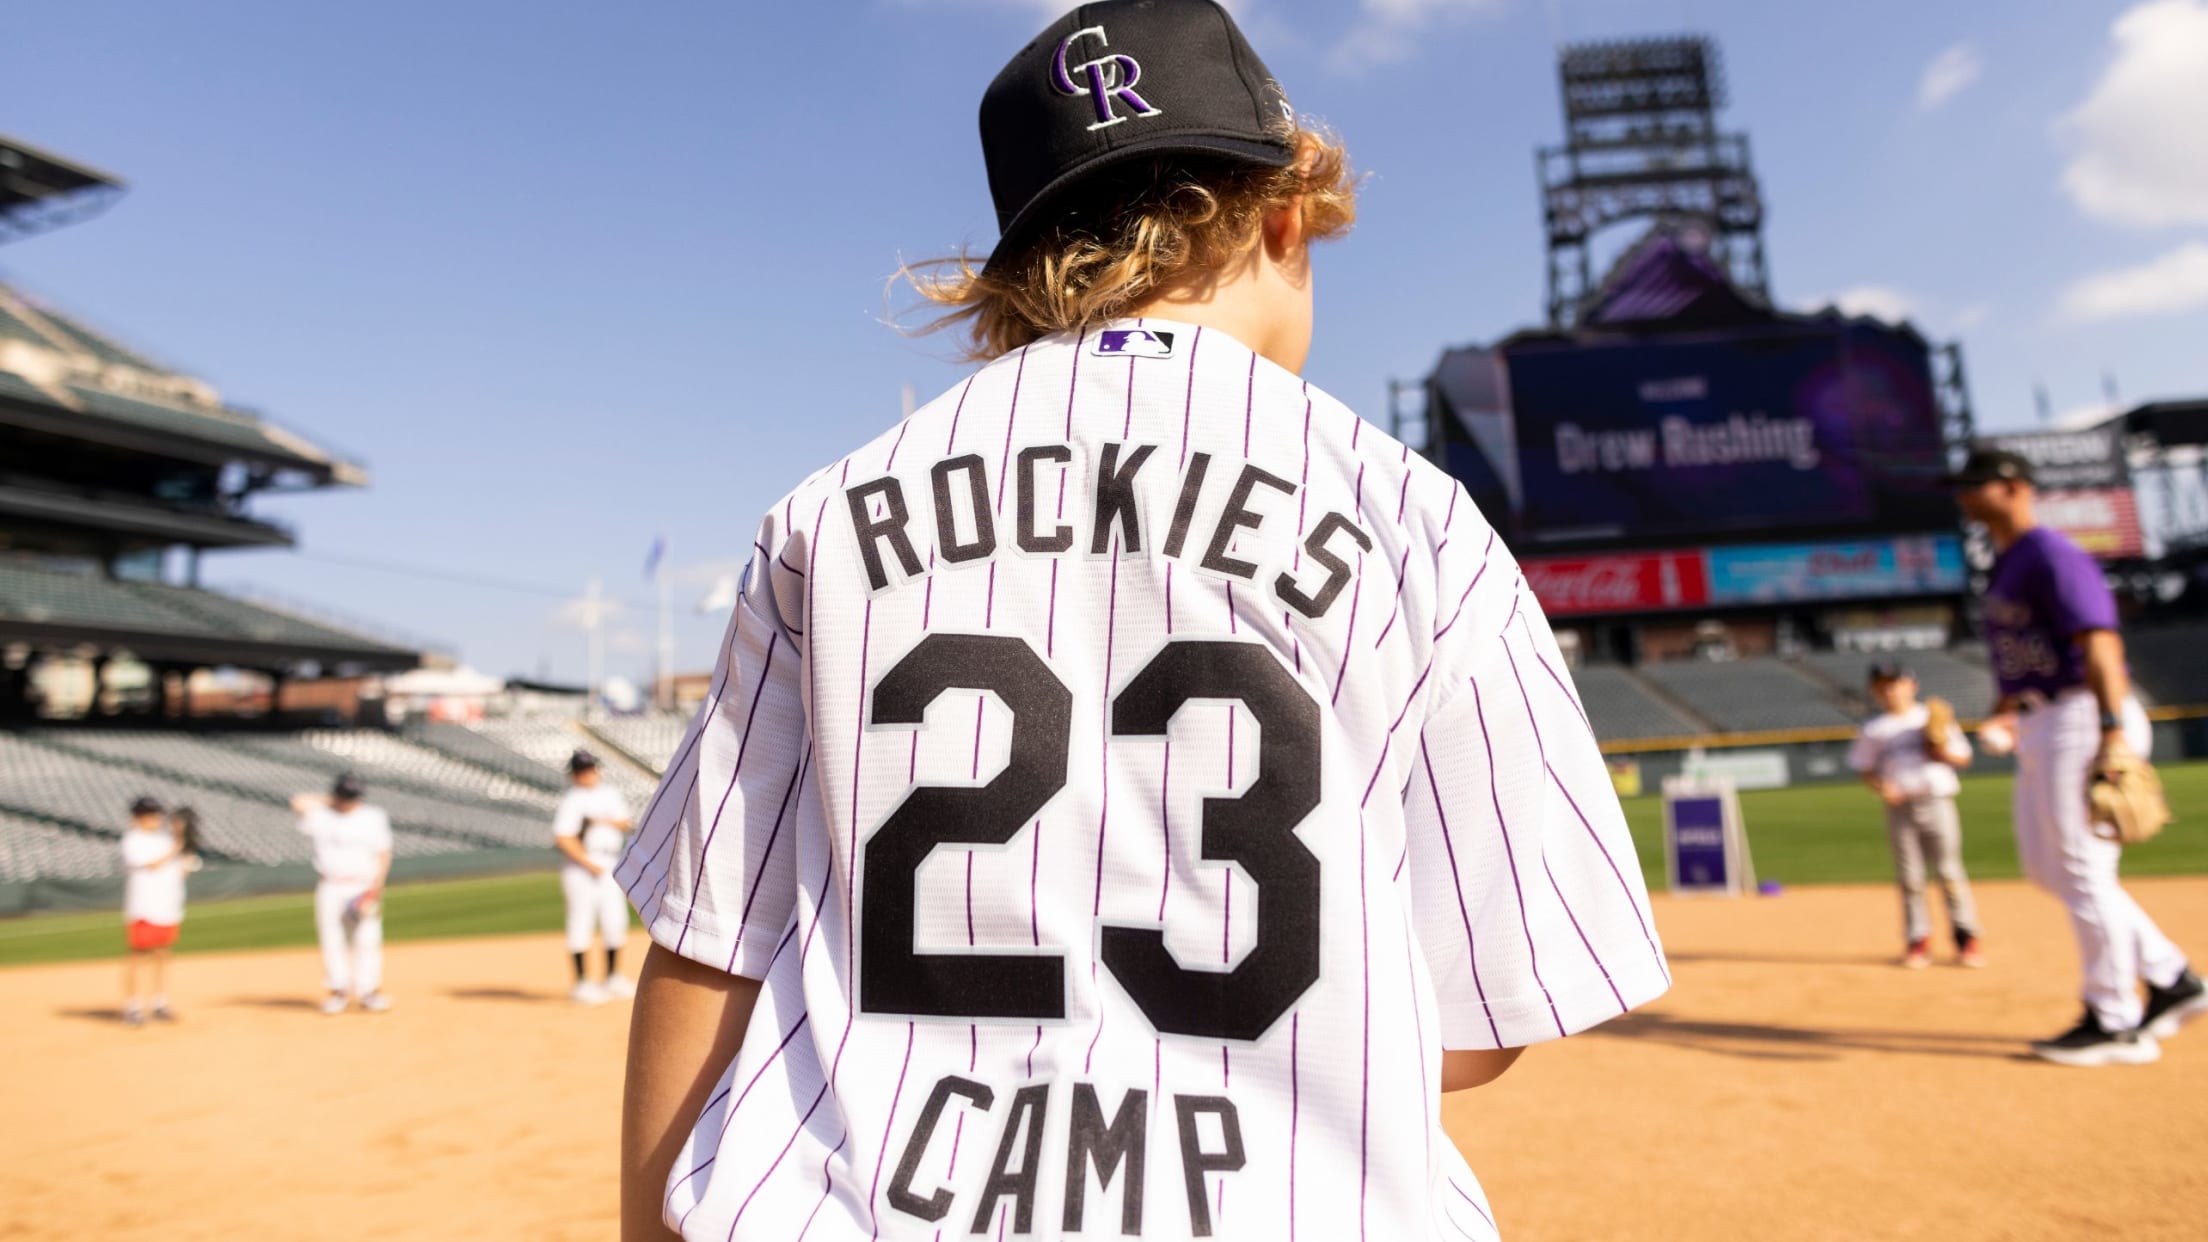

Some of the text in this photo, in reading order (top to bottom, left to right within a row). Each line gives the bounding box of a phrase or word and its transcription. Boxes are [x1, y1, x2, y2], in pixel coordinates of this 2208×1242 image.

[1050, 26, 1161, 131] CR
[1555, 411, 1821, 474] Drew Rushing
[845, 442, 1373, 619] ROCKIES
[860, 633, 1322, 1041] 23
[887, 1075, 1247, 1237] CAMP
